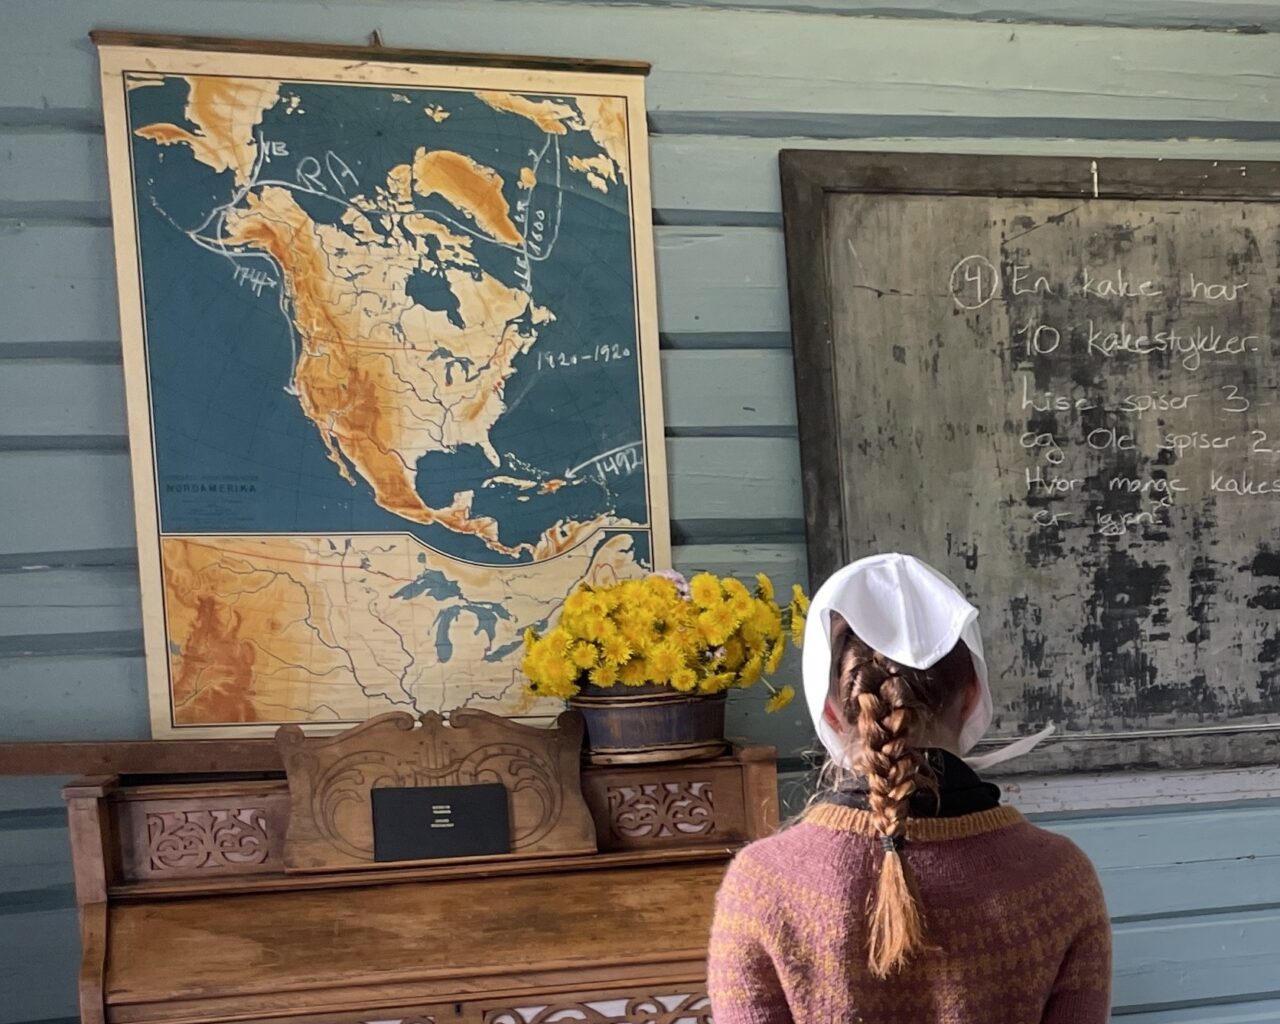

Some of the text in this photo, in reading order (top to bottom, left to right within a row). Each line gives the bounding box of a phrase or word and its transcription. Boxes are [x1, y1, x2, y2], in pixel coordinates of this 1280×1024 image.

[1012, 265, 1056, 295] En
[1083, 268, 1162, 298] kake
[1190, 273, 1249, 300] har
[1018, 317, 1060, 356] 10
[1119, 391, 1200, 419] spiser
[1019, 431, 1065, 464] og
[1087, 427, 1137, 452] Ole
[1156, 430, 1237, 458] spiser
[1025, 466, 1085, 494] Hvor
[1033, 509, 1073, 527] er
